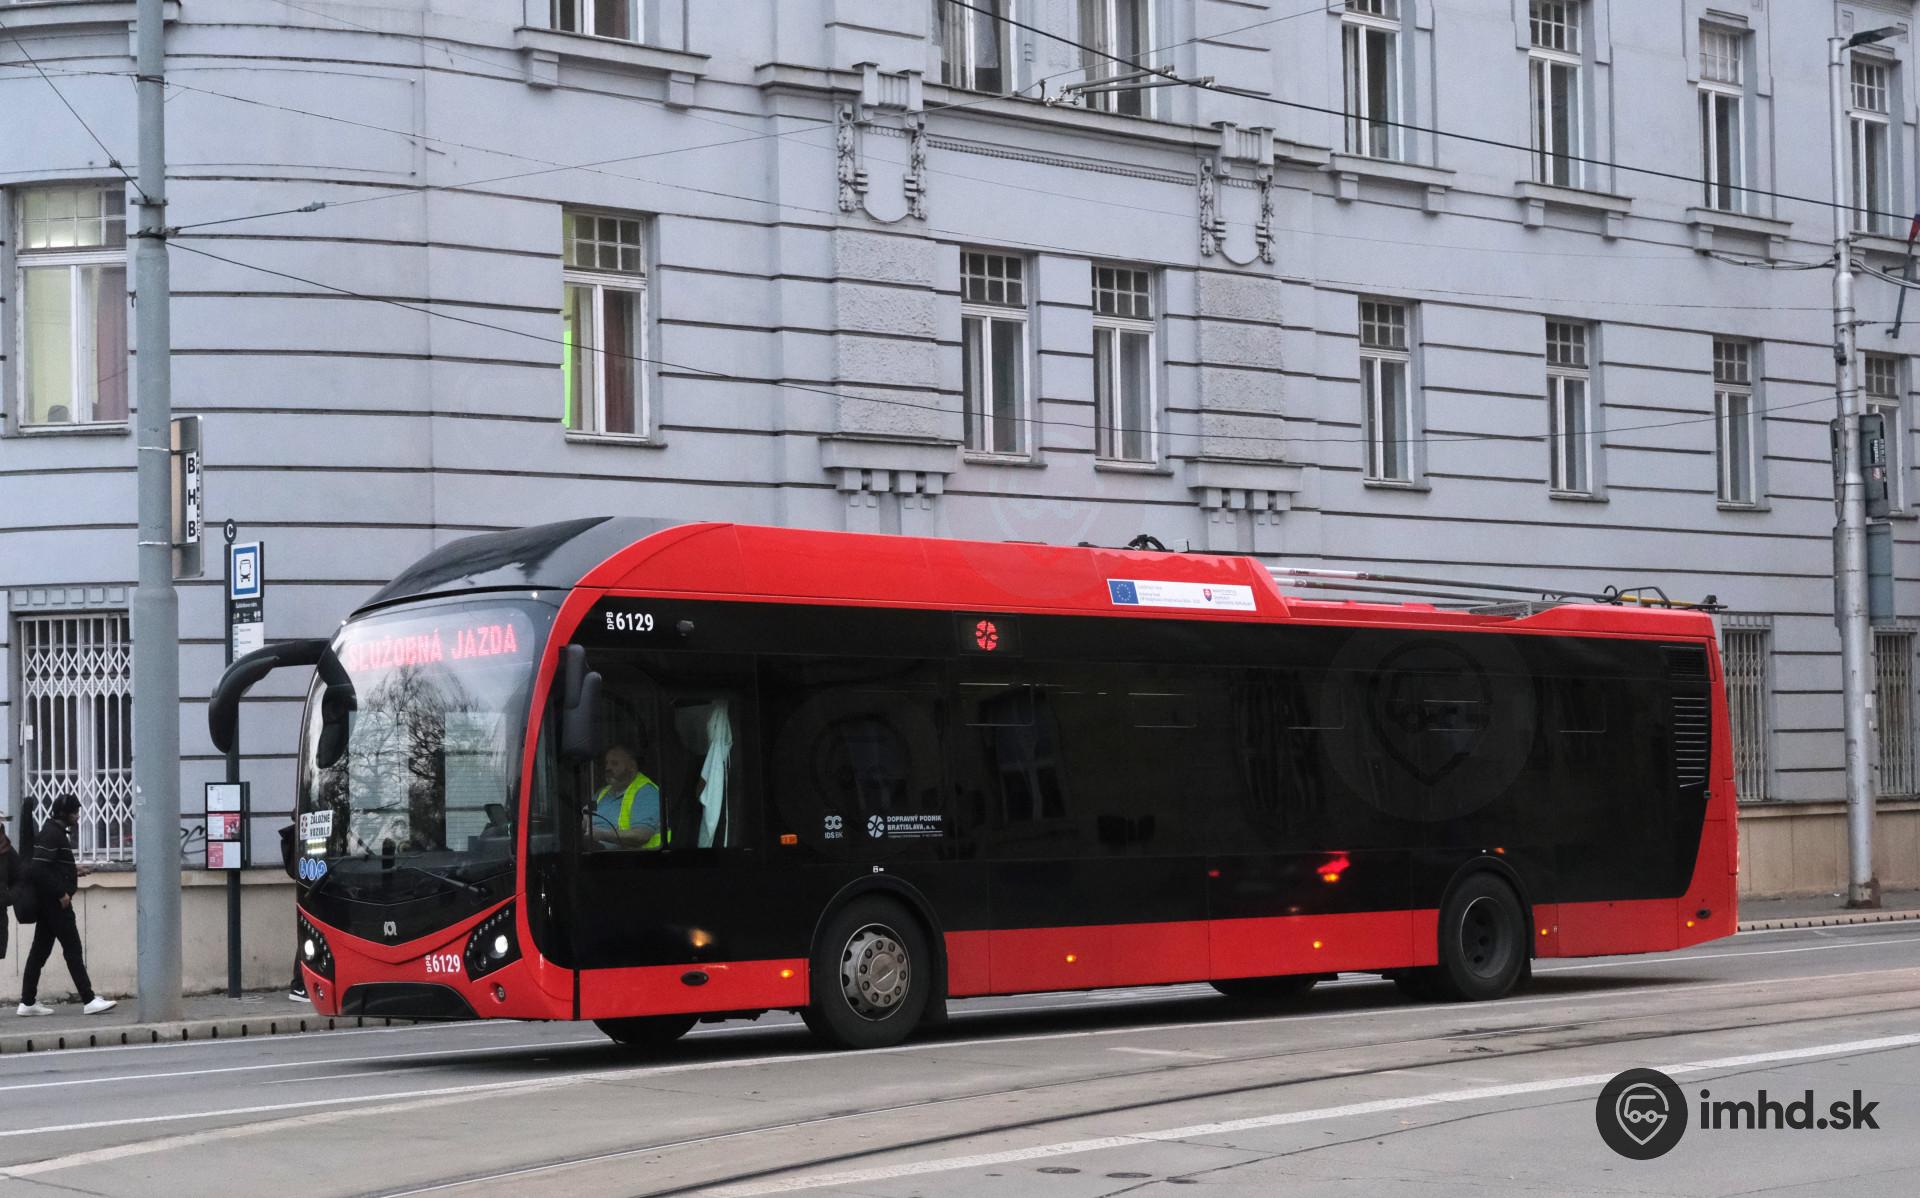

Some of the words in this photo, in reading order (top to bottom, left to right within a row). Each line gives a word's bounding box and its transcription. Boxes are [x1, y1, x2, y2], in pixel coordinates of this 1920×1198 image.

[227, 525, 234, 538] C
[606, 611, 614, 630] DPB
[616, 612, 654, 631] 6129
[452, 623, 517, 660] JAZDA
[432, 954, 461, 973] 6129
